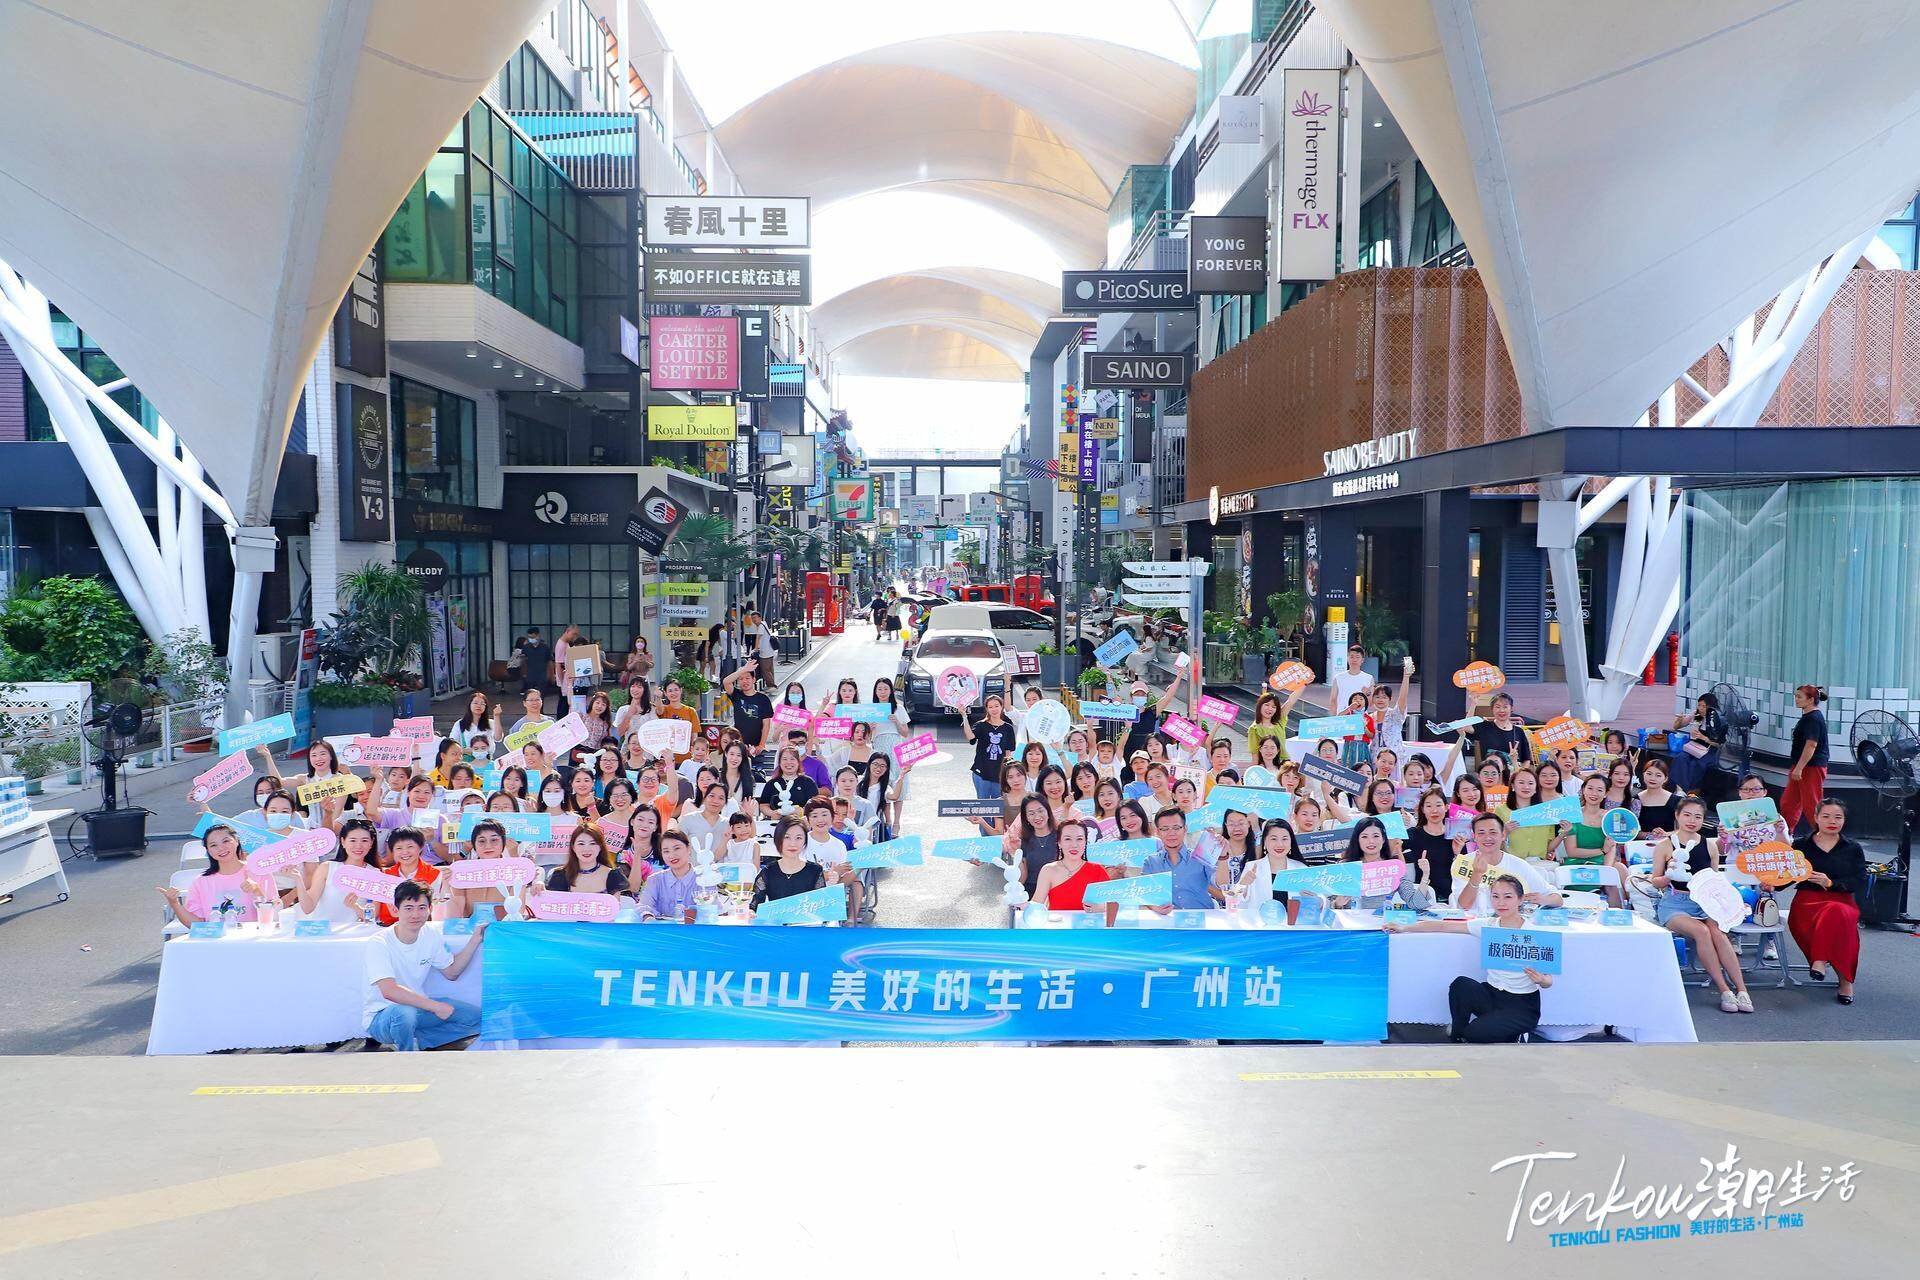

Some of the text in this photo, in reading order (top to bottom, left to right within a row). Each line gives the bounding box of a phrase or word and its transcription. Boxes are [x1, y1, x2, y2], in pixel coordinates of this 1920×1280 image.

[1298, 120, 1326, 209] thermage
[663, 205, 788, 236] 春風十里
[1293, 213, 1329, 229] FLX
[1204, 238, 1246, 251] YONG
[1196, 259, 1263, 272] FOREVER
[1098, 279, 1183, 299] PicoSure
[658, 334, 728, 348] CARTER
[658, 350, 728, 364] LOUISE
[658, 366, 728, 380] SETTLE
[1106, 361, 1171, 379] SAINO
[655, 424, 730, 438] Royal Doulton
[1323, 428, 1418, 477] SAINOBEAUTY
[361, 495, 384, 520] Y-3
[407, 567, 443, 576] MELODY
[304, 785, 346, 801] 自由的快乐
[1488, 942, 1555, 962] 极简的高端
[593, 965, 1284, 1012] TENKOU 美好的生活·广州站
